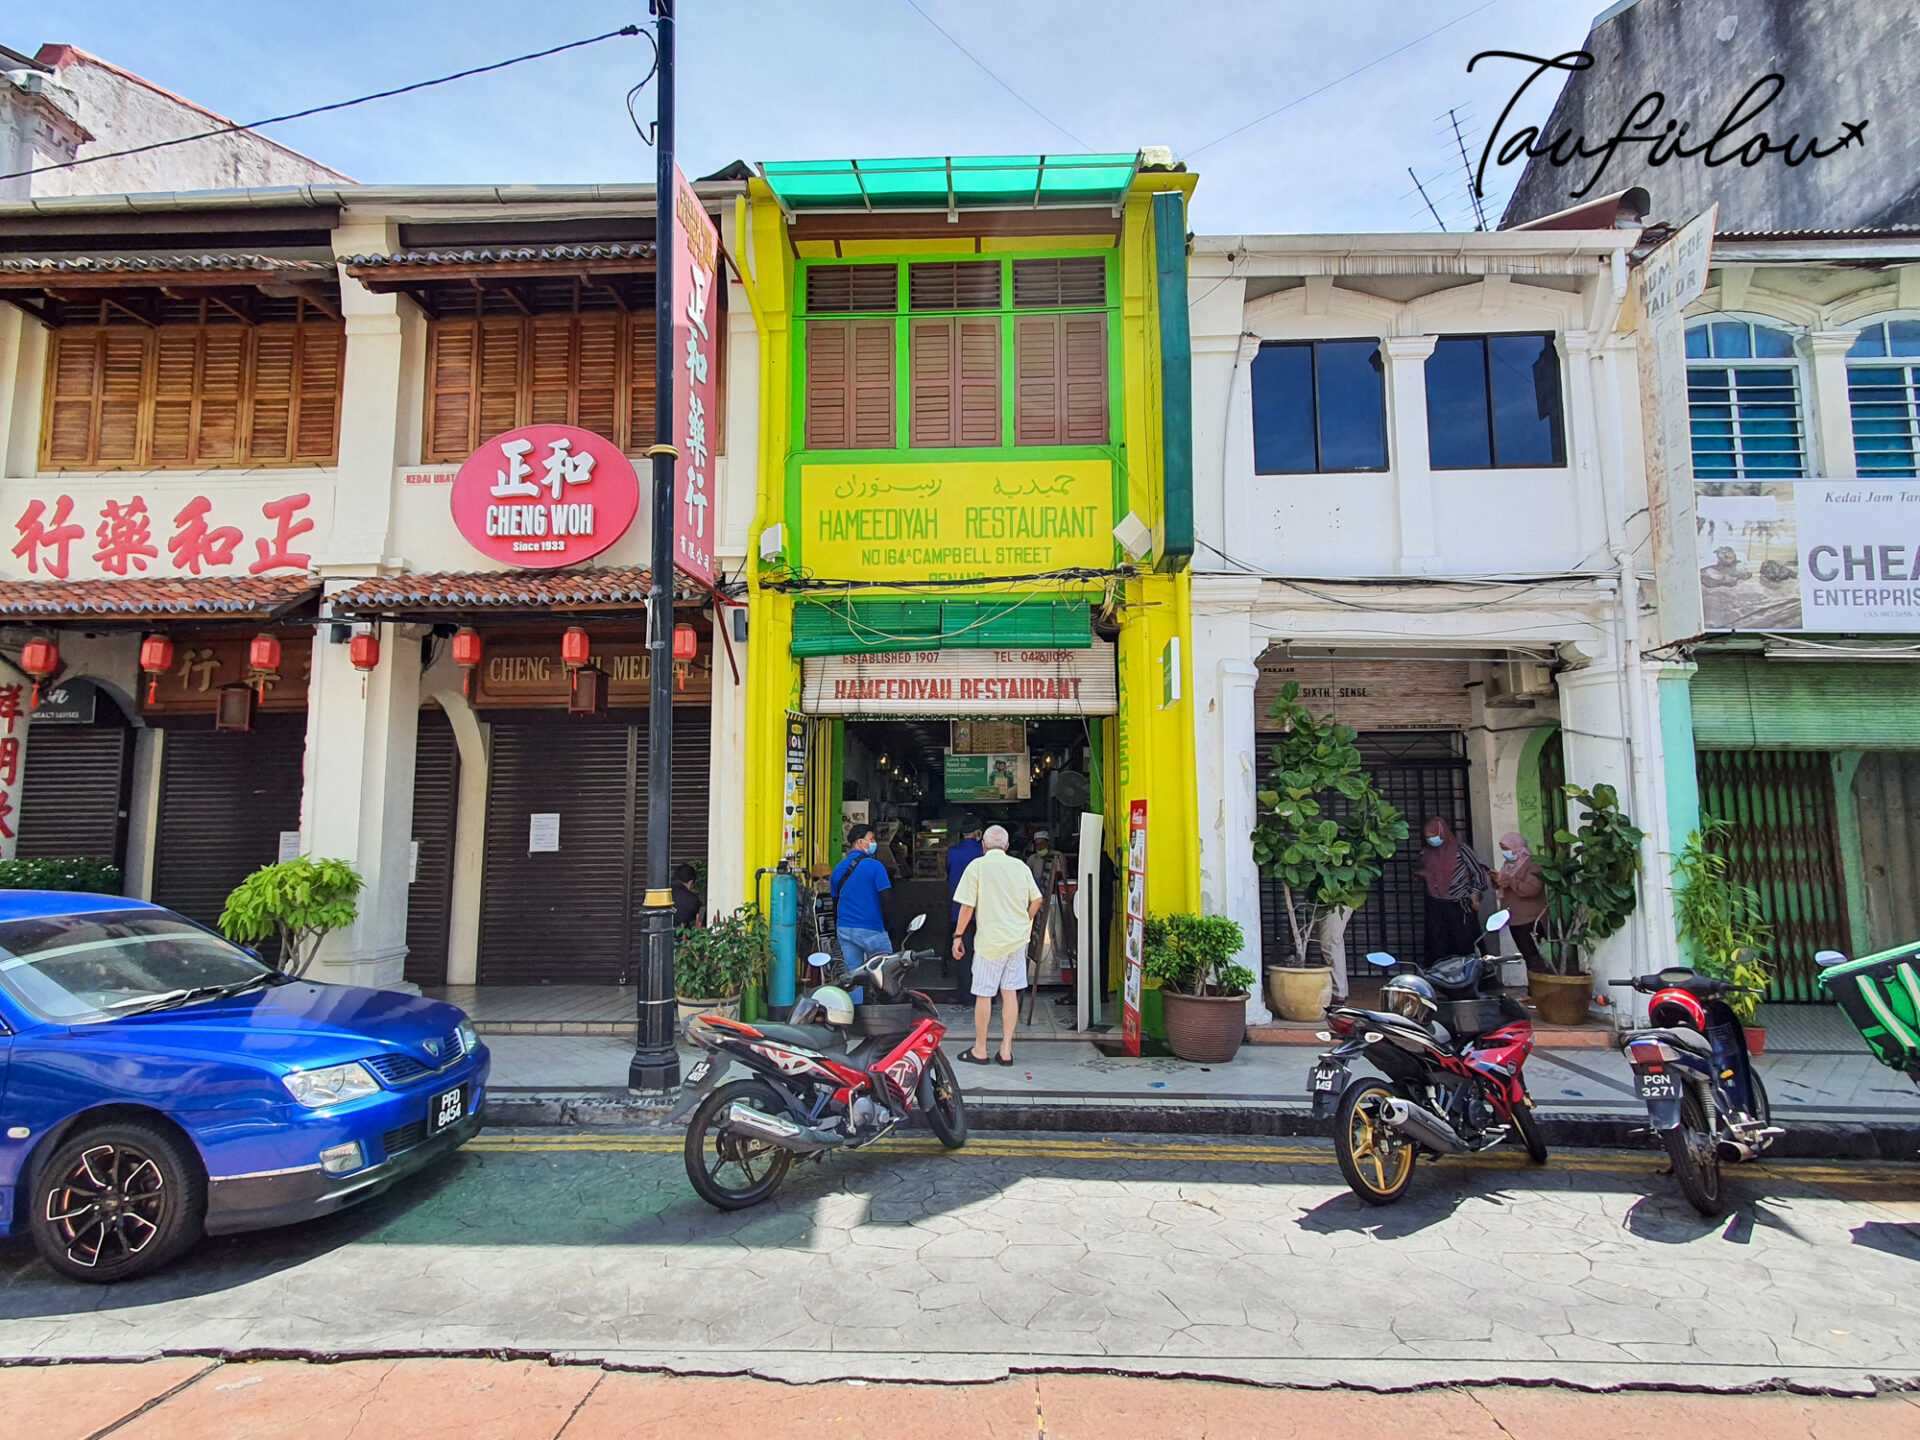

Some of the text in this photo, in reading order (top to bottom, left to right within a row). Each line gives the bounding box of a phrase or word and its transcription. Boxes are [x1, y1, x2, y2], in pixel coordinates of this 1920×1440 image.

[1645, 269, 1697, 319] TAILOR
[490, 438, 597, 500] 正和
[406, 474, 432, 484] KEDAI
[1825, 492, 1863, 503] Kedai
[1865, 492, 1893, 503] Jam
[485, 503, 595, 538] CHENG WOH
[819, 505, 1098, 542] HAMEEDIYAH RESTAURANT
[513, 539, 566, 552] Since 1933
[862, 548, 881, 565] NO
[912, 547, 993, 565] CAMPBELL
[995, 546, 1053, 564] STREET
[843, 652, 912, 664] ESTABLISHED
[915, 651, 940, 664] 1907
[489, 656, 550, 681] CHENG
[959, 677, 1083, 700] RESTAURANT
[1302, 687, 1368, 698] SIXTH SENSE
[1315, 1069, 1335, 1080] ALV
[1643, 1075, 1671, 1085] PGN
[1315, 1080, 1333, 1091] 149
[1641, 1086, 1676, 1097] 3271
[441, 1088, 461, 1110] PFD
[438, 1102, 462, 1127] 8454
